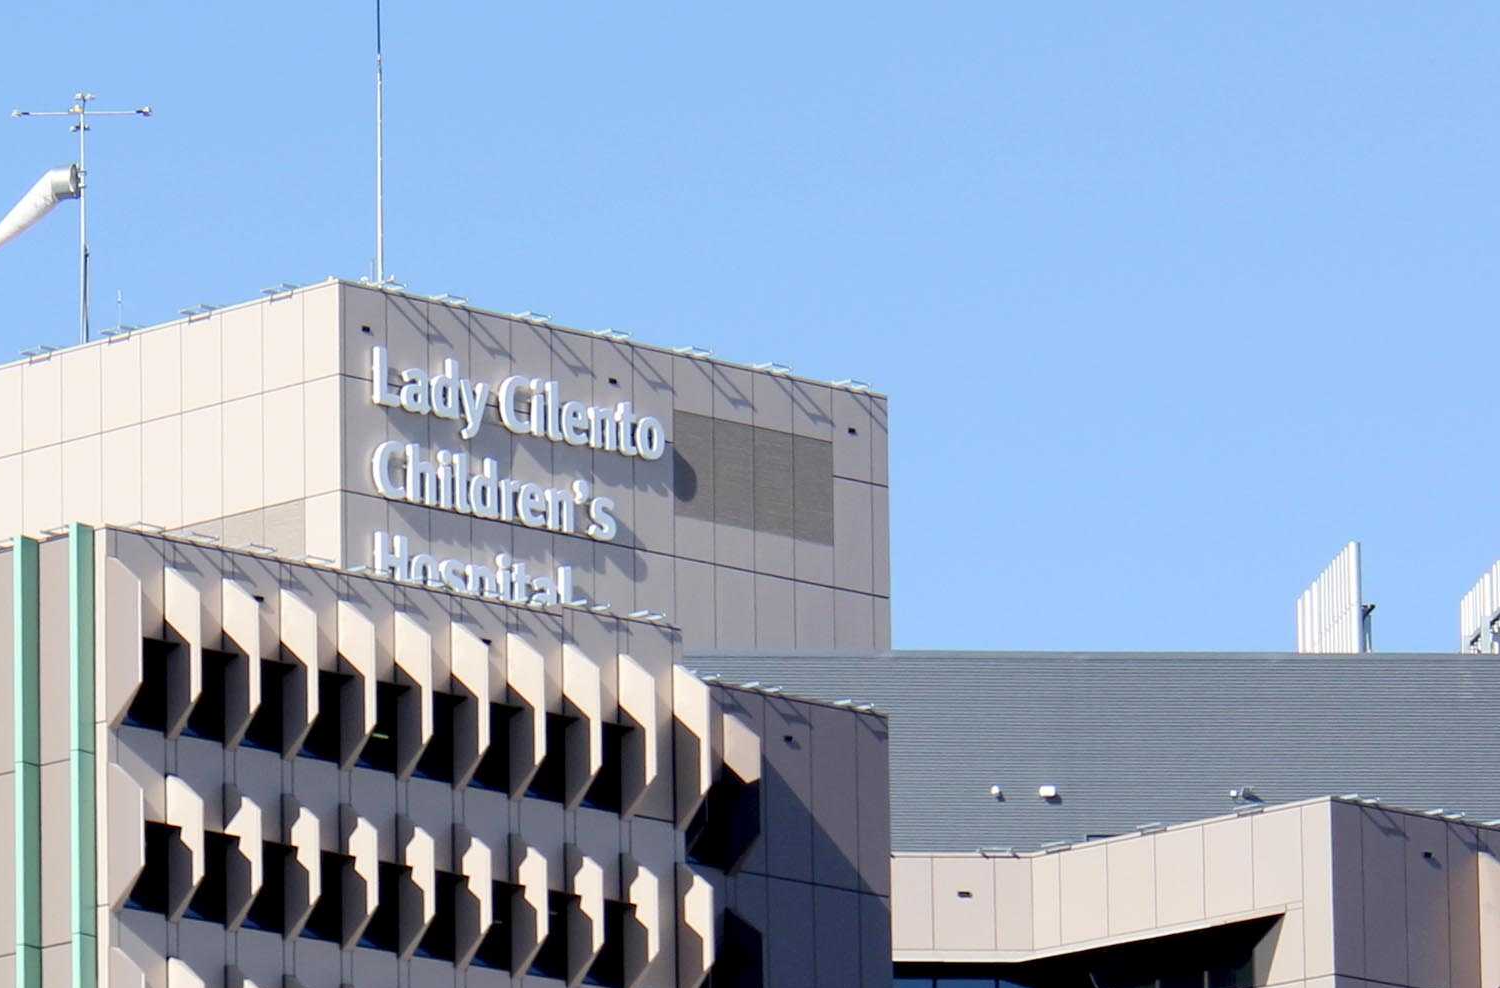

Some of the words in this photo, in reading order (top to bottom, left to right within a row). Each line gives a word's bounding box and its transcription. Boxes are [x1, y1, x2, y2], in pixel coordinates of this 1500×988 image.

[372, 346, 490, 440] Lady
[498, 375, 666, 461] Cilento
[372, 440, 618, 541] Children's
